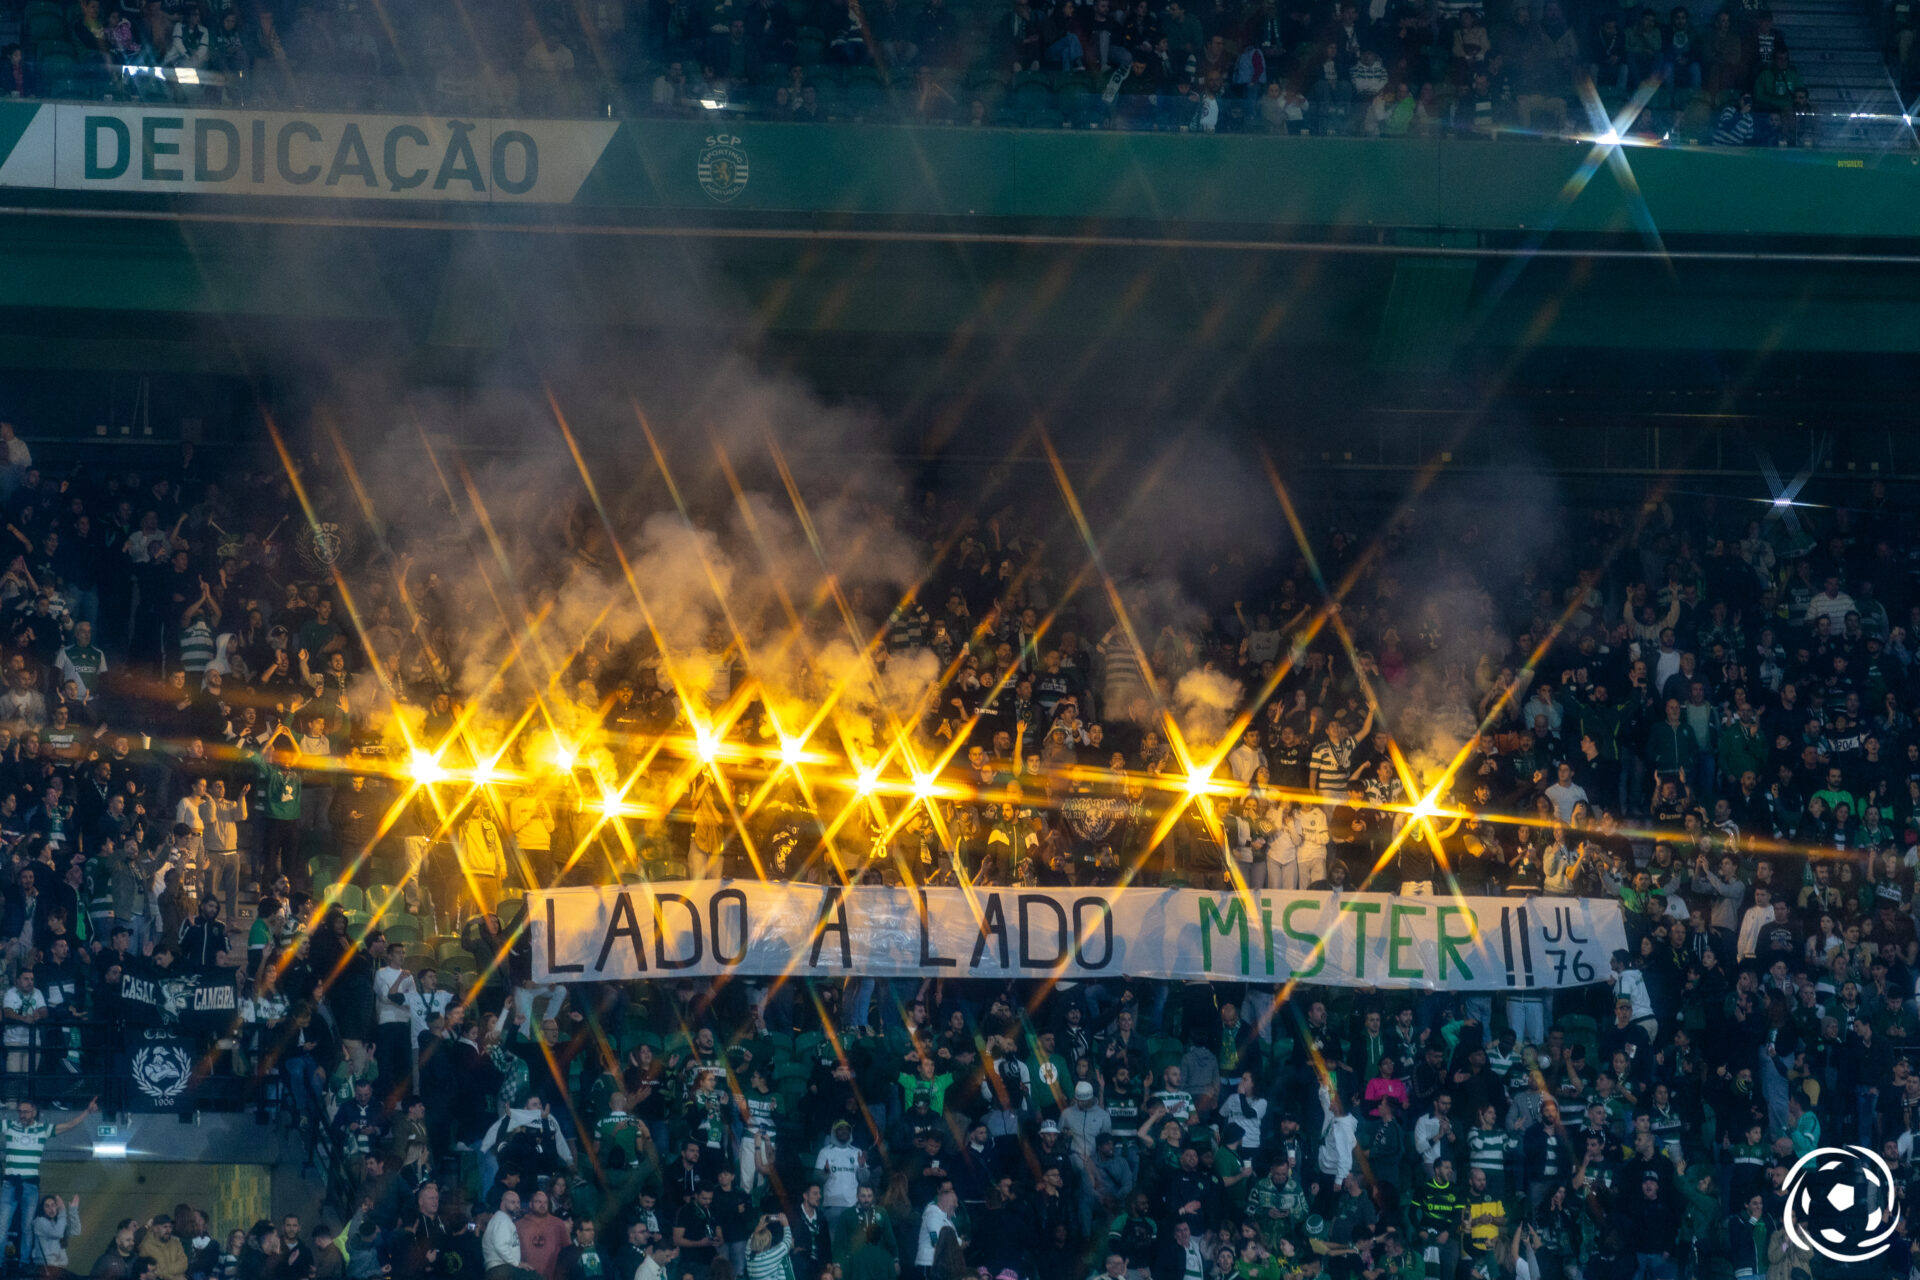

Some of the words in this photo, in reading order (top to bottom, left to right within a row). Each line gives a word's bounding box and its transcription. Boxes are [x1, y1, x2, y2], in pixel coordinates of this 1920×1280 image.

[84, 115, 539, 195] DEDICAÇÃO
[703, 149, 743, 163] SPORTING
[705, 134, 742, 147] SCP
[546, 887, 748, 975] LADO
[809, 886, 853, 969] A
[918, 889, 1114, 971] LADO
[1543, 906, 1589, 945] JL
[1544, 949, 1596, 986] 76
[122, 974, 157, 1005] CASAL
[194, 985, 236, 1011] CAMBRA
[154, 1098, 175, 1107] 1906
